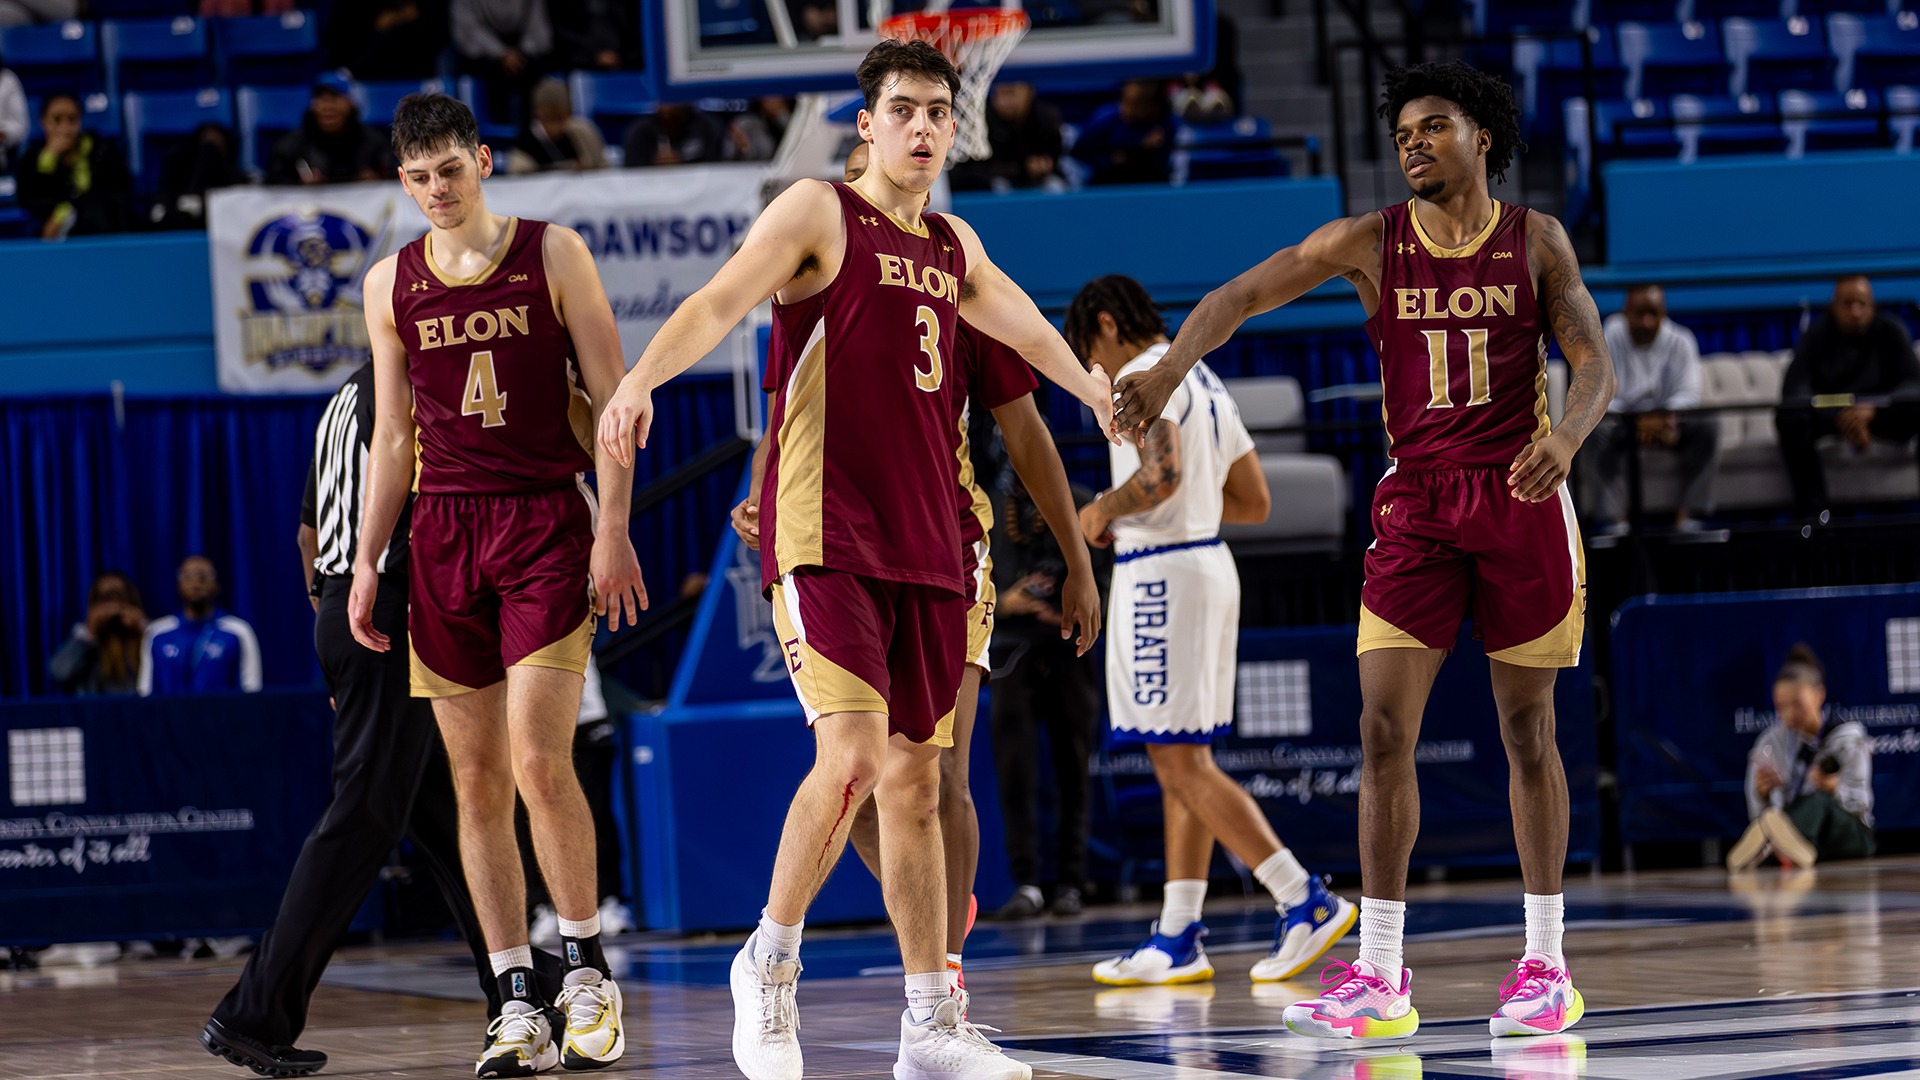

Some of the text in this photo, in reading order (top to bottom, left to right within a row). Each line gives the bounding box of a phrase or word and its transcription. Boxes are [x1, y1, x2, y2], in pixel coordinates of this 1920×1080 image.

[875, 252, 959, 308] ELON
[1492, 251, 1513, 259] CAA
[415, 305, 530, 350] ELON
[1394, 285, 1517, 319] ELON
[914, 305, 943, 392] 3
[1420, 328, 1492, 409] 11
[461, 351, 507, 428] 4
[1134, 578, 1167, 706] PIRATES
